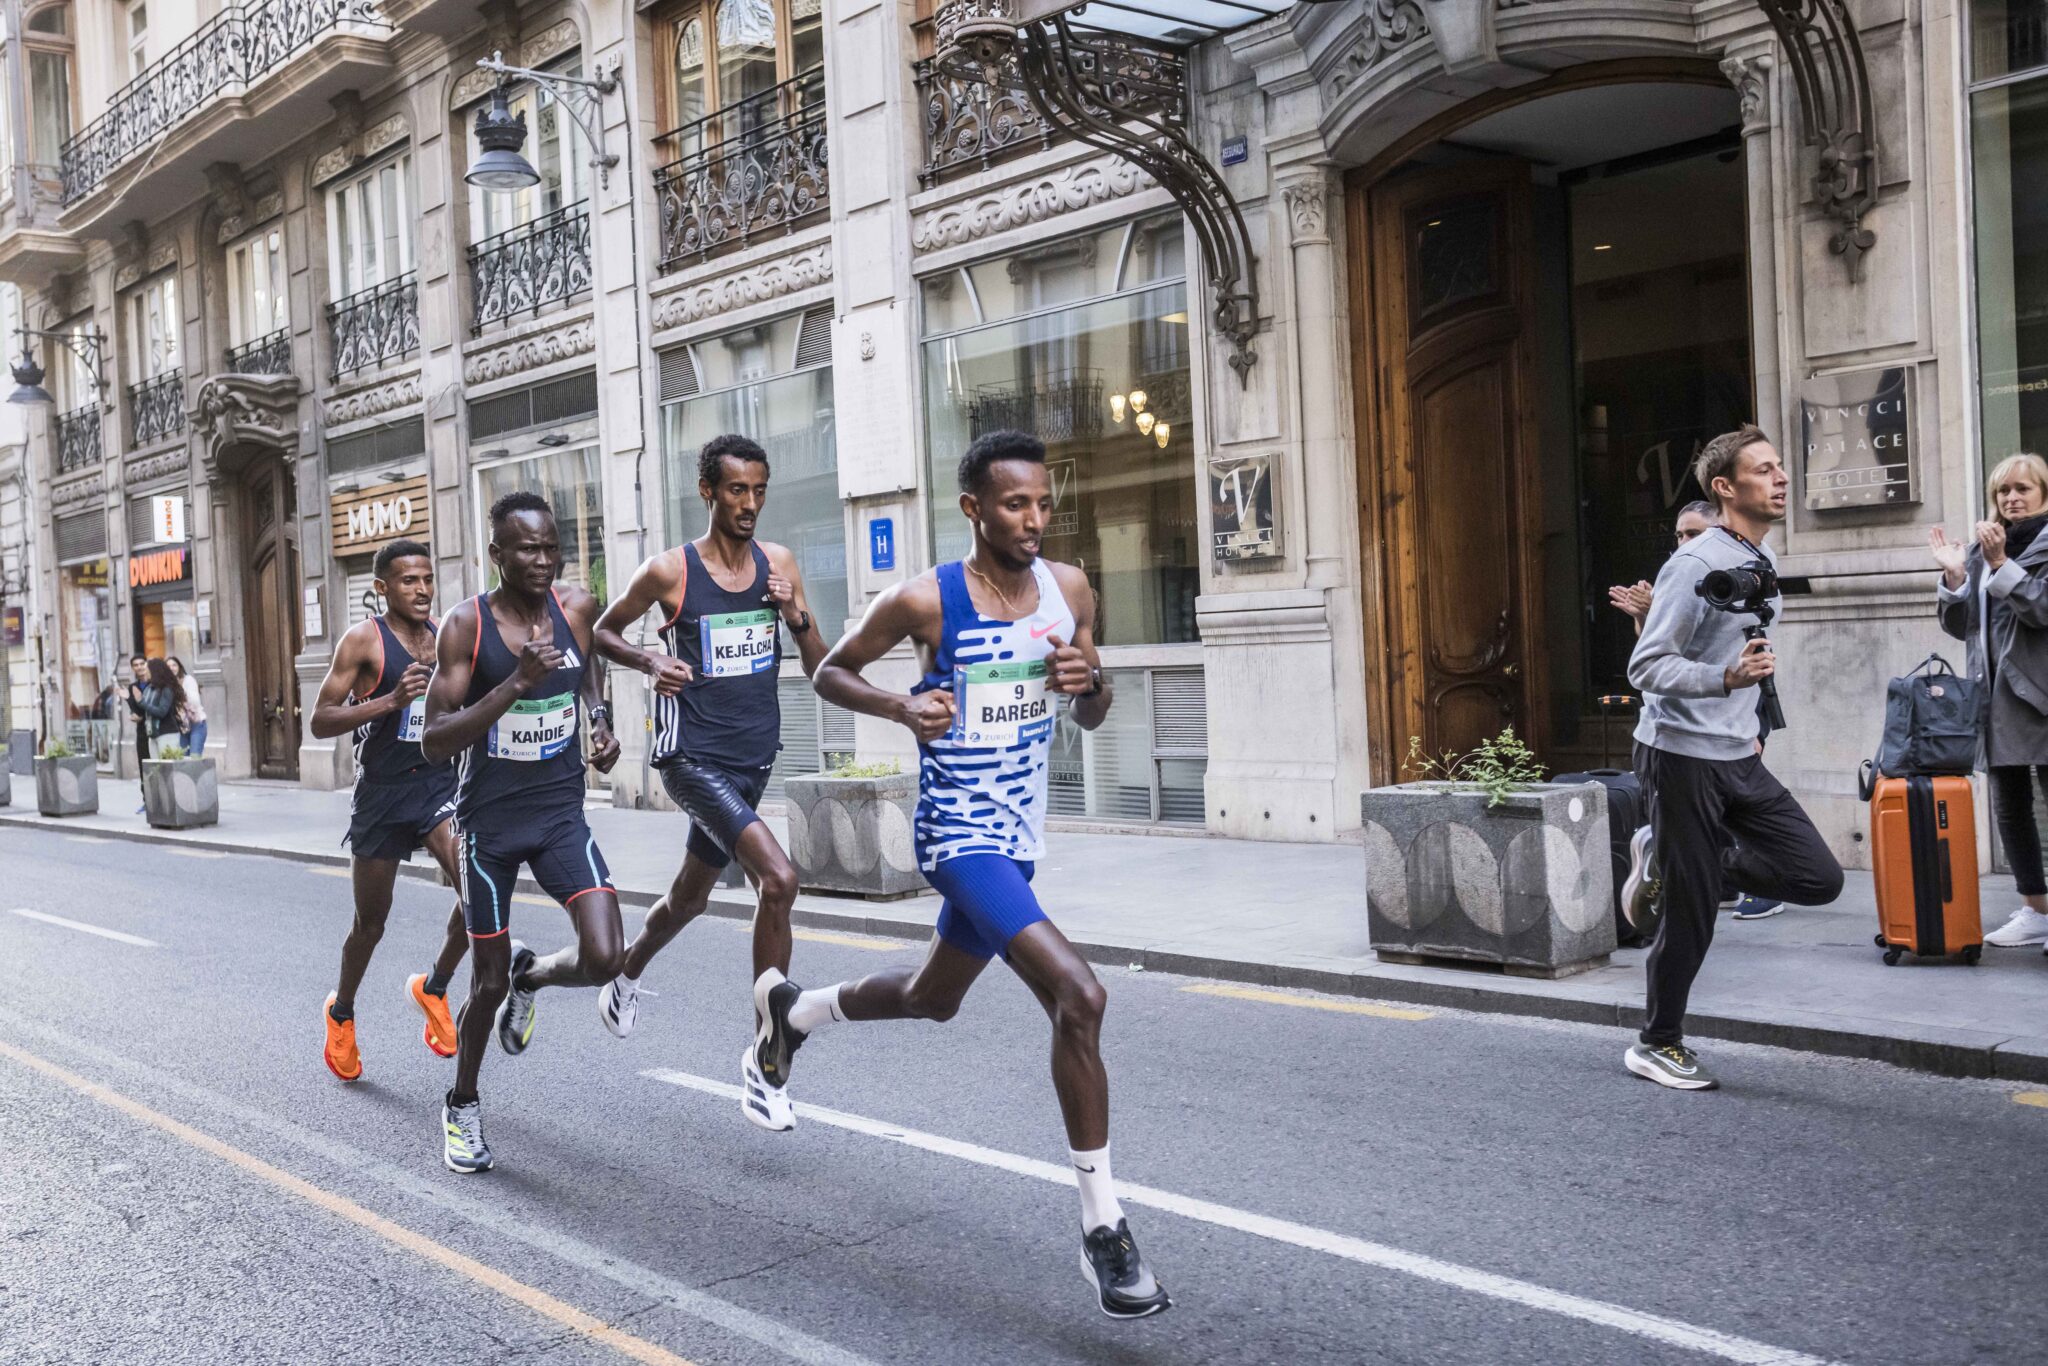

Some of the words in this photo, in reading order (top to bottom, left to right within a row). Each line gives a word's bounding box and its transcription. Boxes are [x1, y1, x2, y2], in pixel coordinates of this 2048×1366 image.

[1807, 400, 1902, 422] VINCCI
[1807, 434, 1903, 456] PALACE
[1818, 468, 1895, 486] HOTEL
[348, 495, 412, 541] MUMO
[129, 548, 185, 588] DUNKIN'
[745, 628, 754, 640] 2
[715, 639, 772, 660] KEJELCHA
[1014, 684, 1024, 700] 9
[981, 699, 1047, 723] BAREGA
[537, 716, 543, 728] 1
[512, 725, 565, 743] KANDIE
[984, 733, 1014, 742] ZURICH
